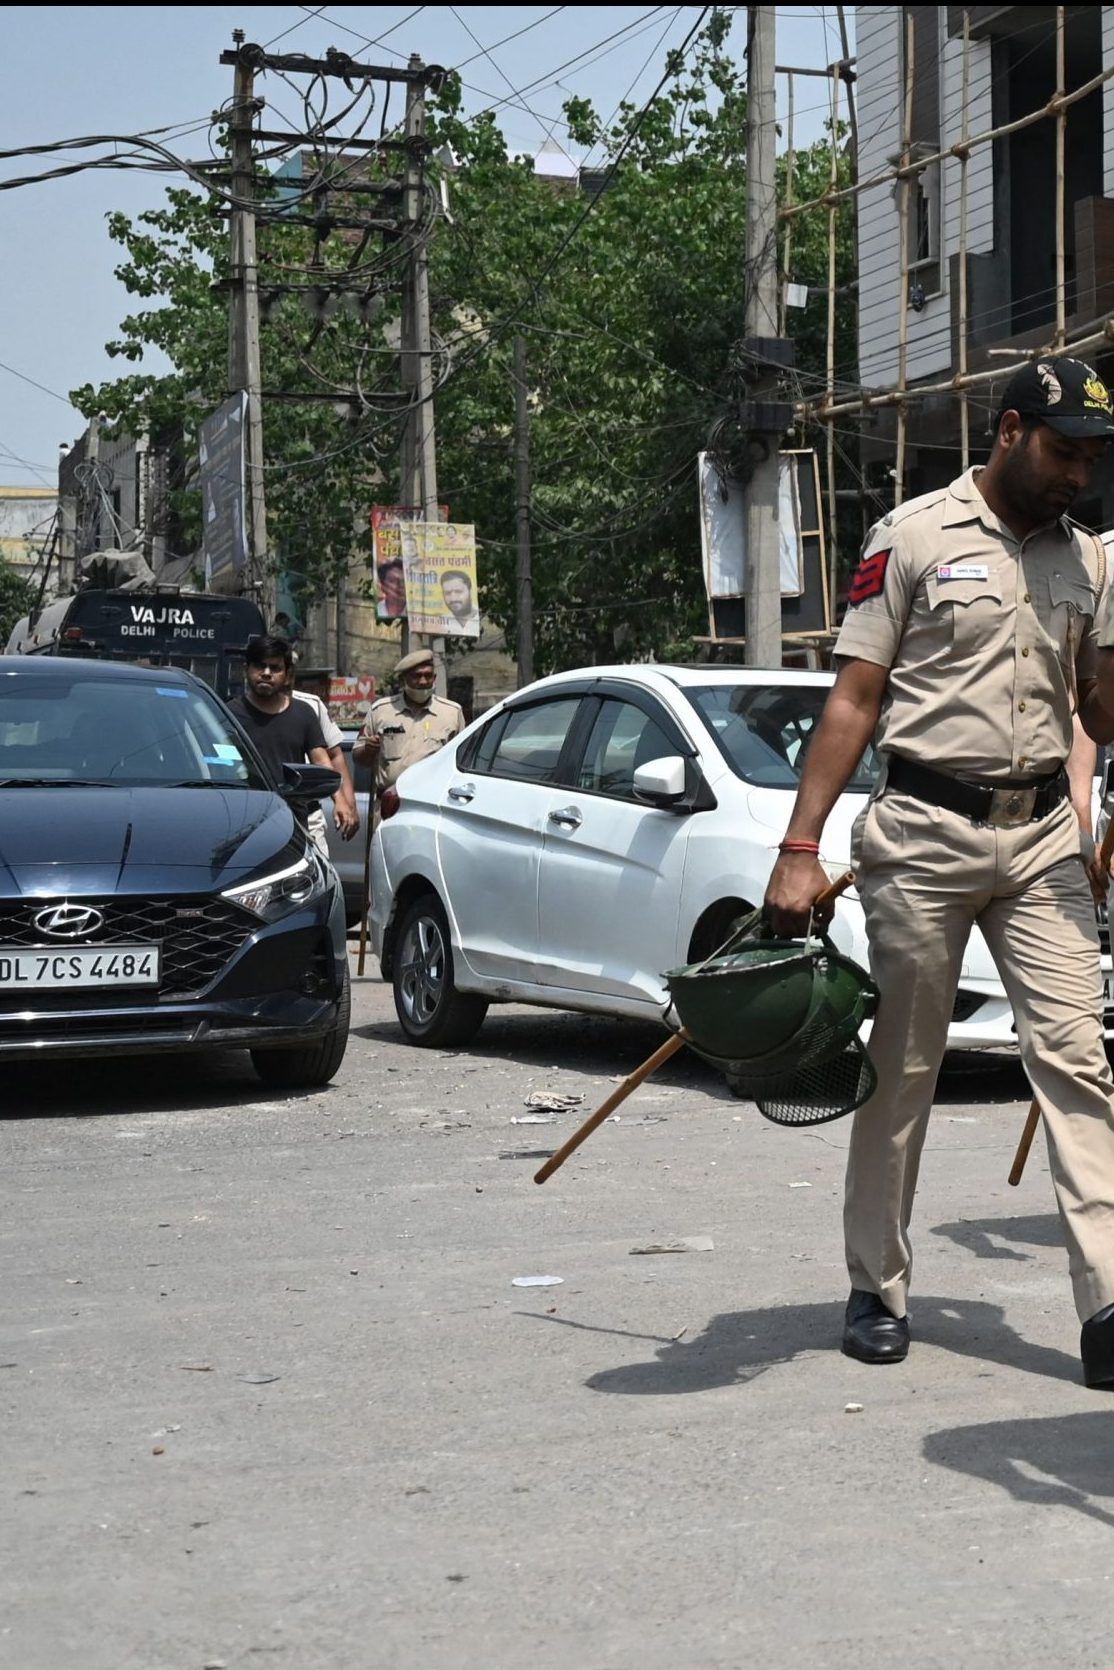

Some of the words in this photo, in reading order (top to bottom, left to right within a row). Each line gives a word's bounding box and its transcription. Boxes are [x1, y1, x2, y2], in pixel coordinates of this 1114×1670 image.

[130, 605, 194, 625] VAJRA
[121, 625, 155, 637] DELHI
[173, 627, 215, 639] POLICE
[0, 957, 28, 982] DL
[36, 956, 82, 981] 7CS
[90, 954, 151, 979] 4484
